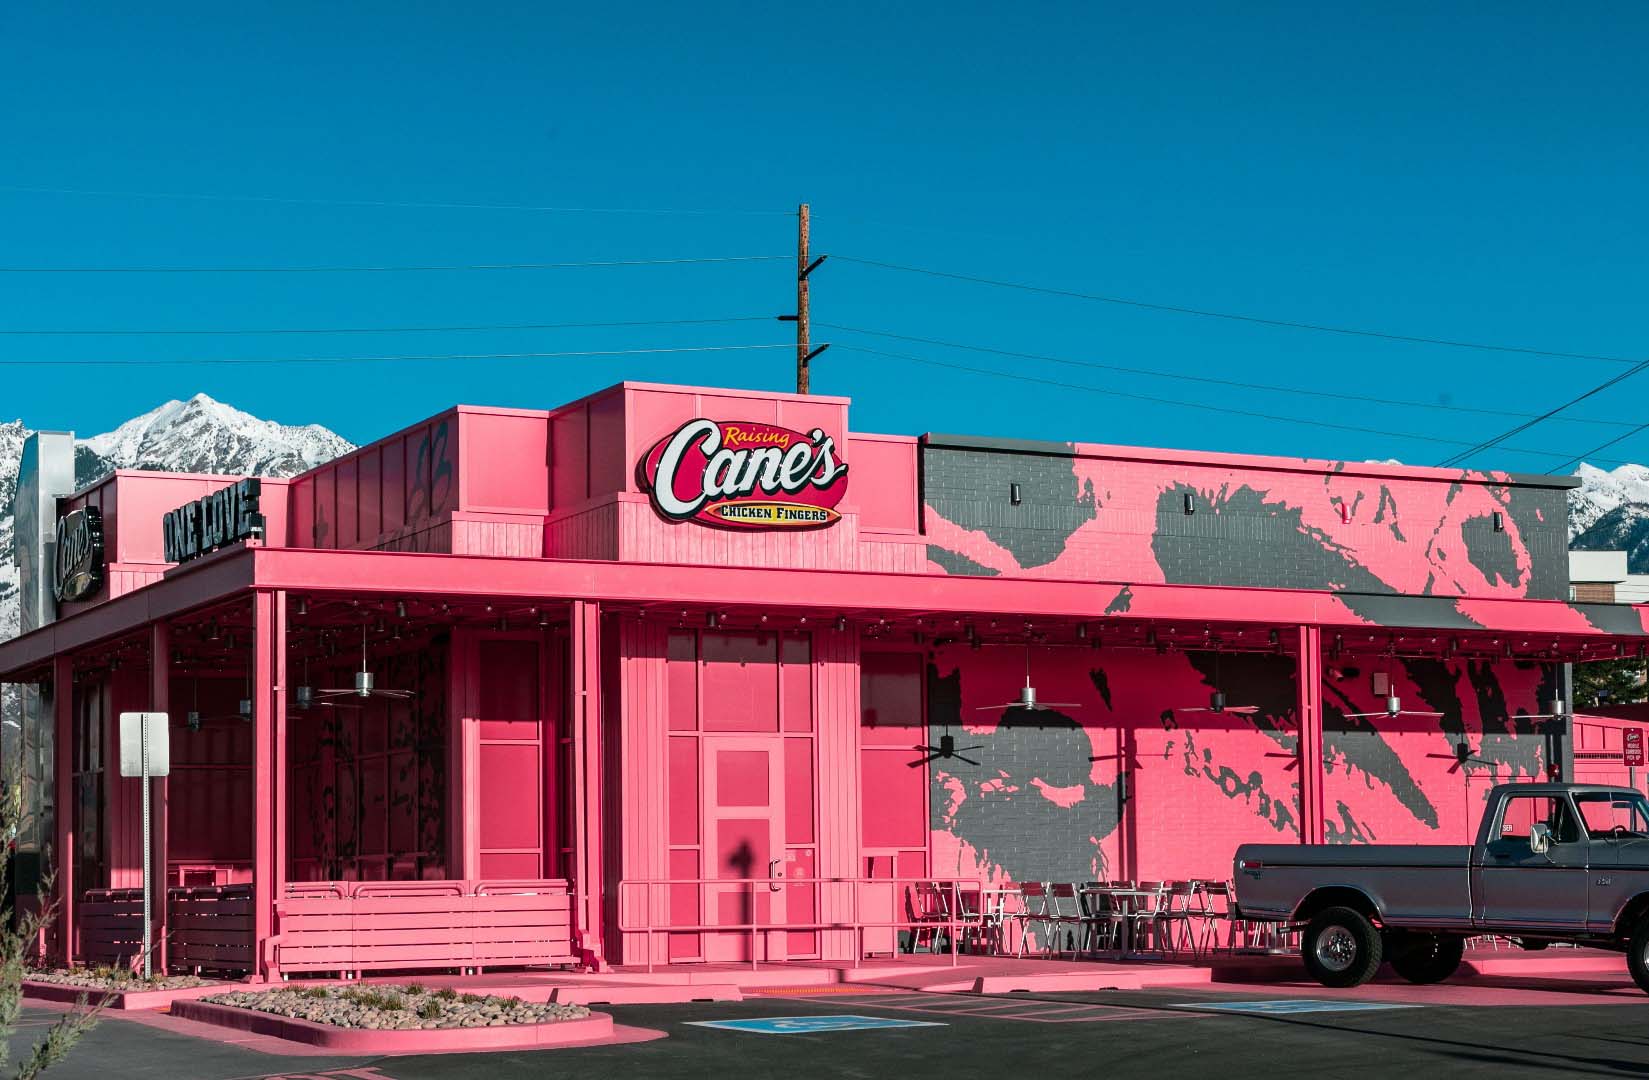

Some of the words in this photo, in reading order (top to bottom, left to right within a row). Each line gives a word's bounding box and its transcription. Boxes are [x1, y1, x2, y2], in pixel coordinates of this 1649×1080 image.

[724, 427, 789, 448] Raising
[655, 419, 847, 515] Cane's
[163, 500, 198, 563] ONE
[201, 477, 251, 550] LOVE
[721, 505, 772, 518] CHICKEN
[776, 507, 827, 521] FINGERS
